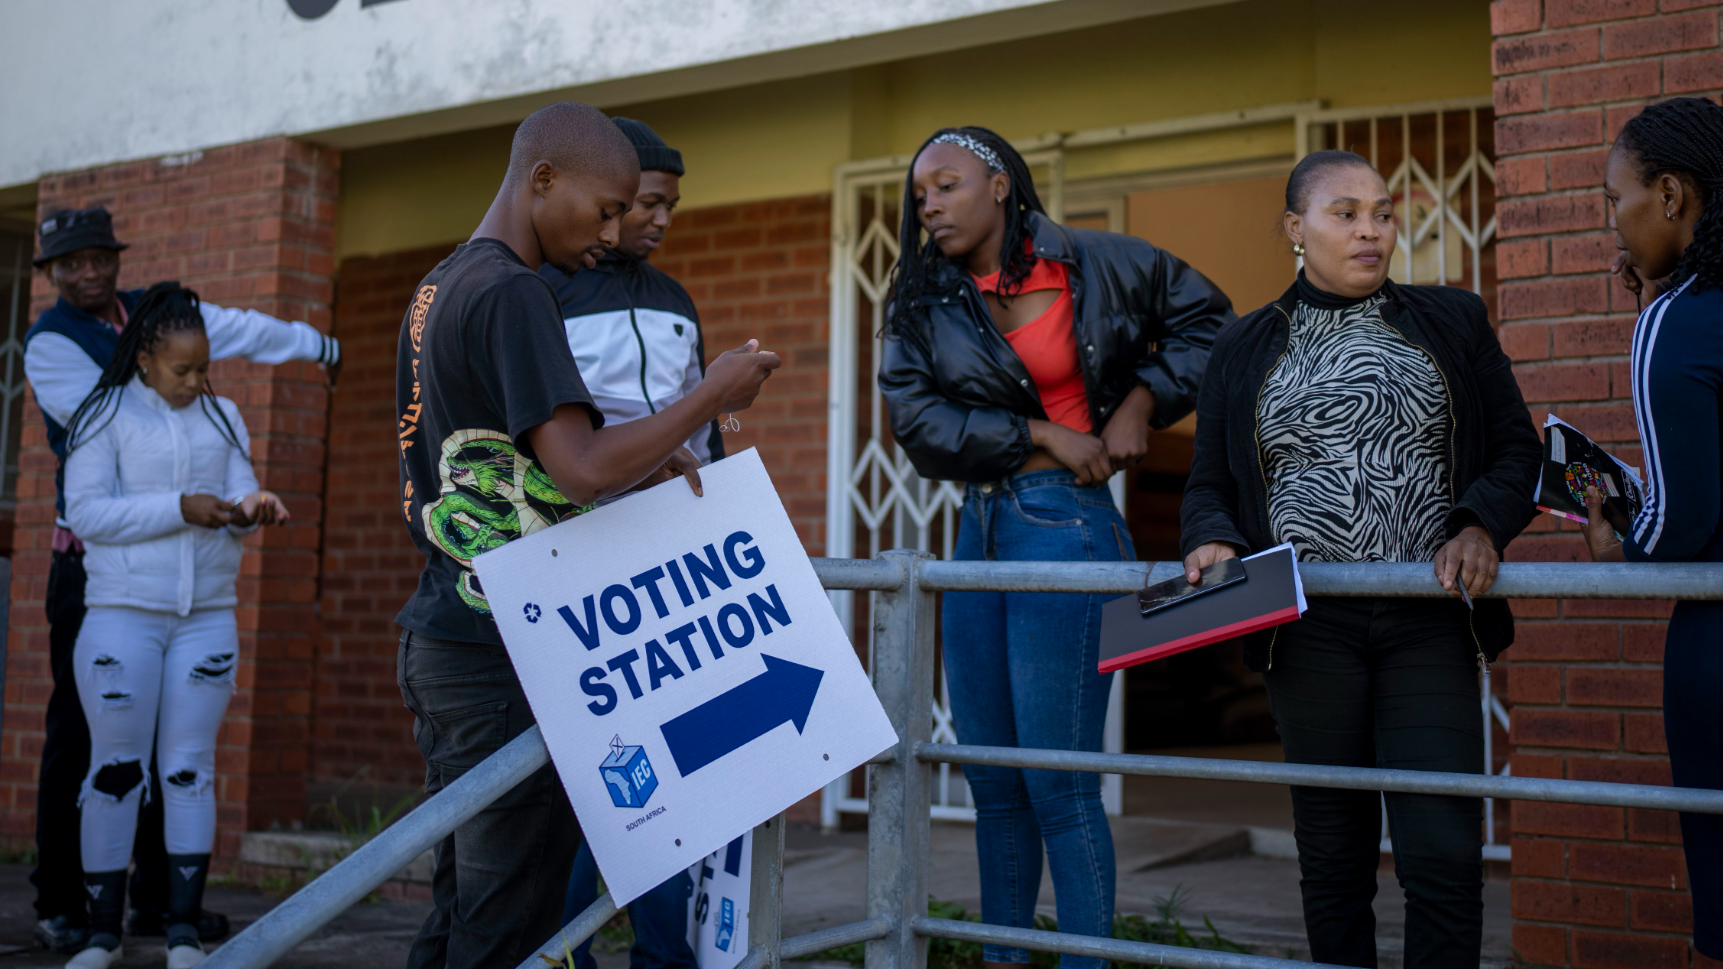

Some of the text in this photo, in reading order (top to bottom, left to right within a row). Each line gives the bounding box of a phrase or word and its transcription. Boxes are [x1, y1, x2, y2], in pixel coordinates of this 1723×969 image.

[557, 530, 766, 651] VOTING
[579, 583, 792, 716] STATION
[631, 758, 651, 791] IEC
[625, 805, 667, 832] SOUTH AFRICA
